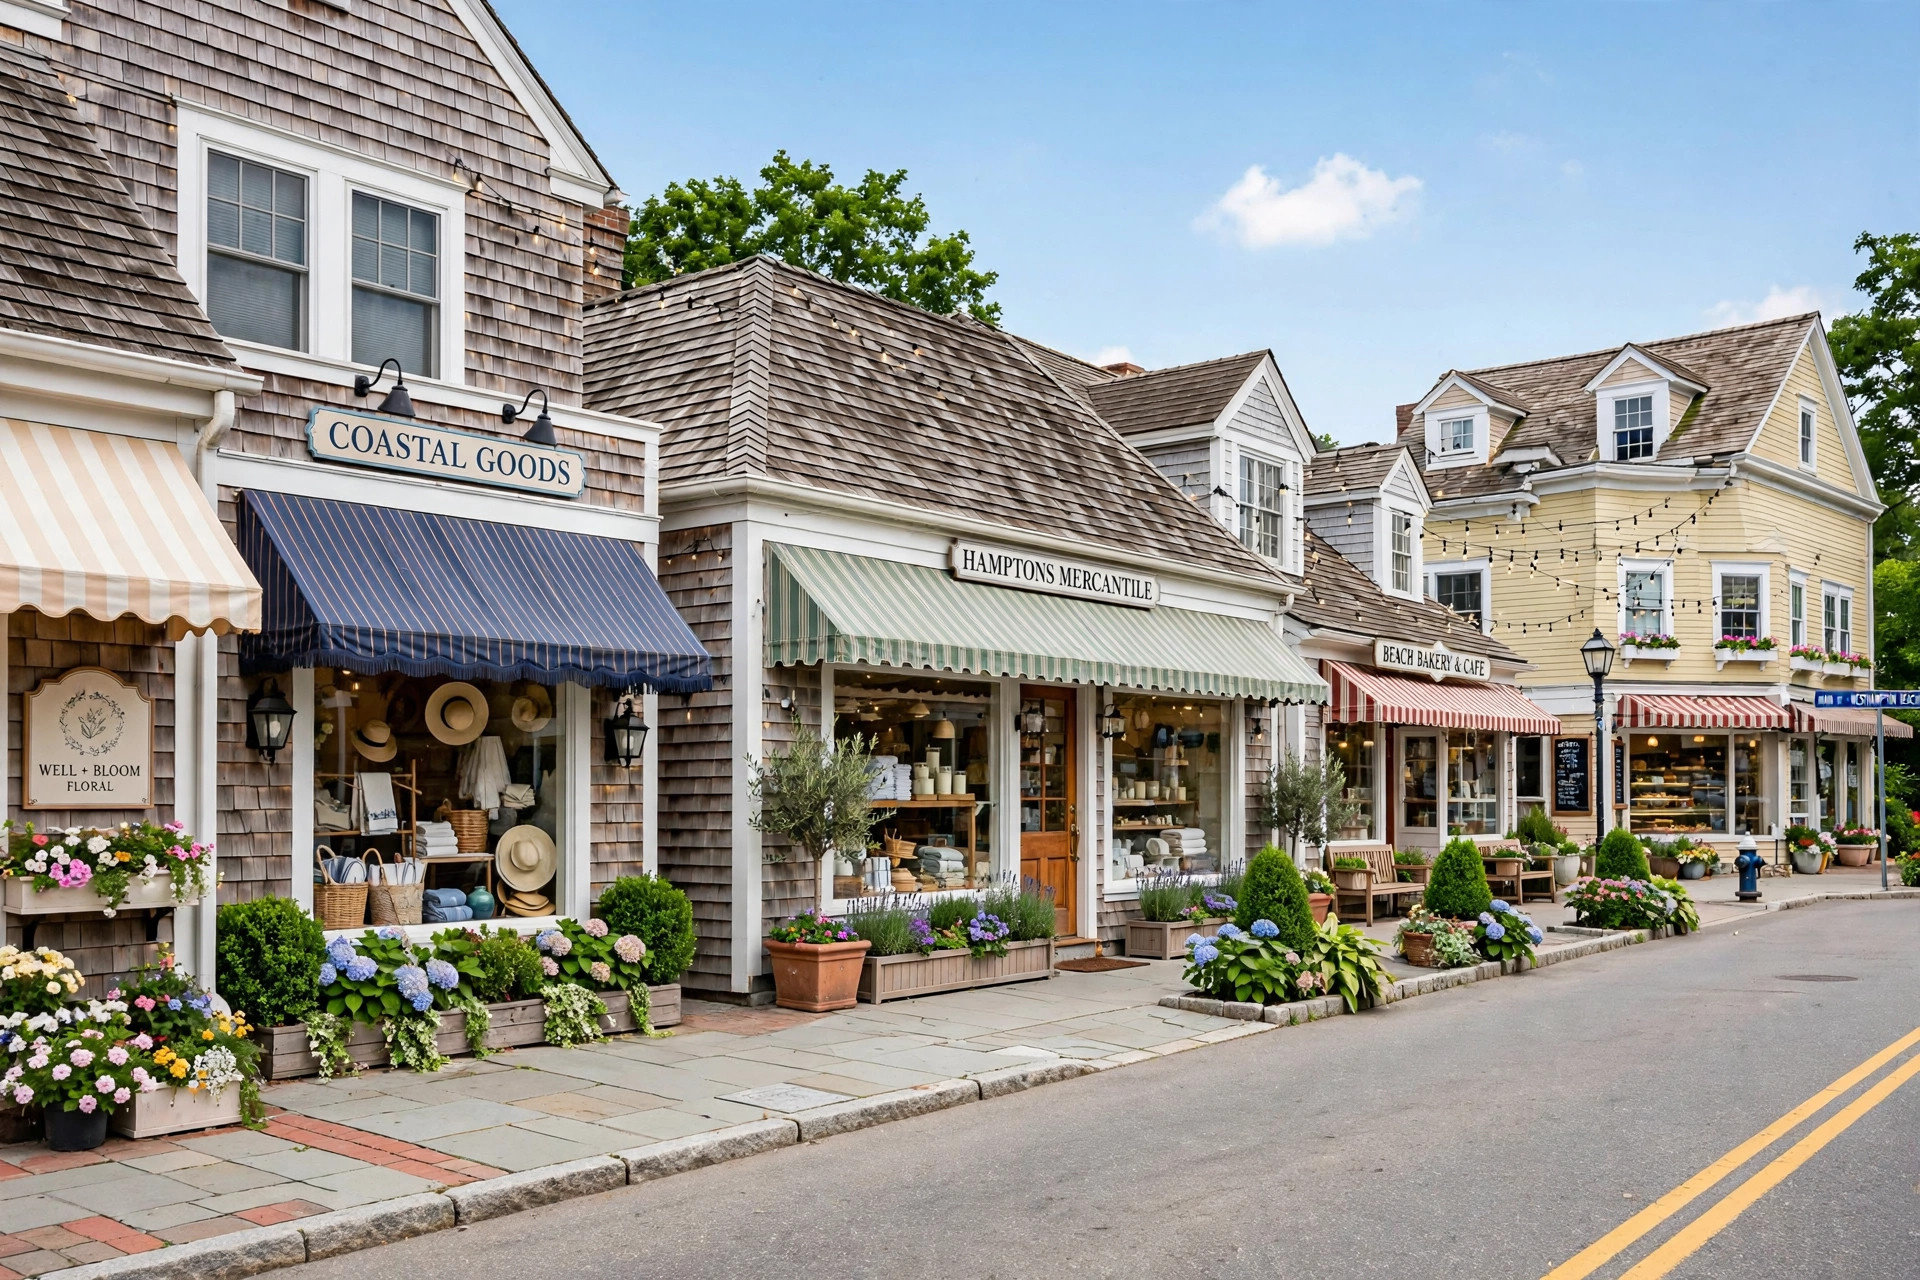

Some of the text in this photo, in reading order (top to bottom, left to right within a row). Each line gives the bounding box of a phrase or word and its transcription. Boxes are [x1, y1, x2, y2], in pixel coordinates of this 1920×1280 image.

[329, 421, 570, 486] COASTAL GOODS
[963, 549, 1153, 600] HAMPTONS MERCANTILE
[1383, 645, 1485, 677] BEACH BAKERY & CAFE
[39, 764, 77, 777] WELL
[93, 764, 141, 777] BLOOM
[67, 780, 114, 792] FLORAL
